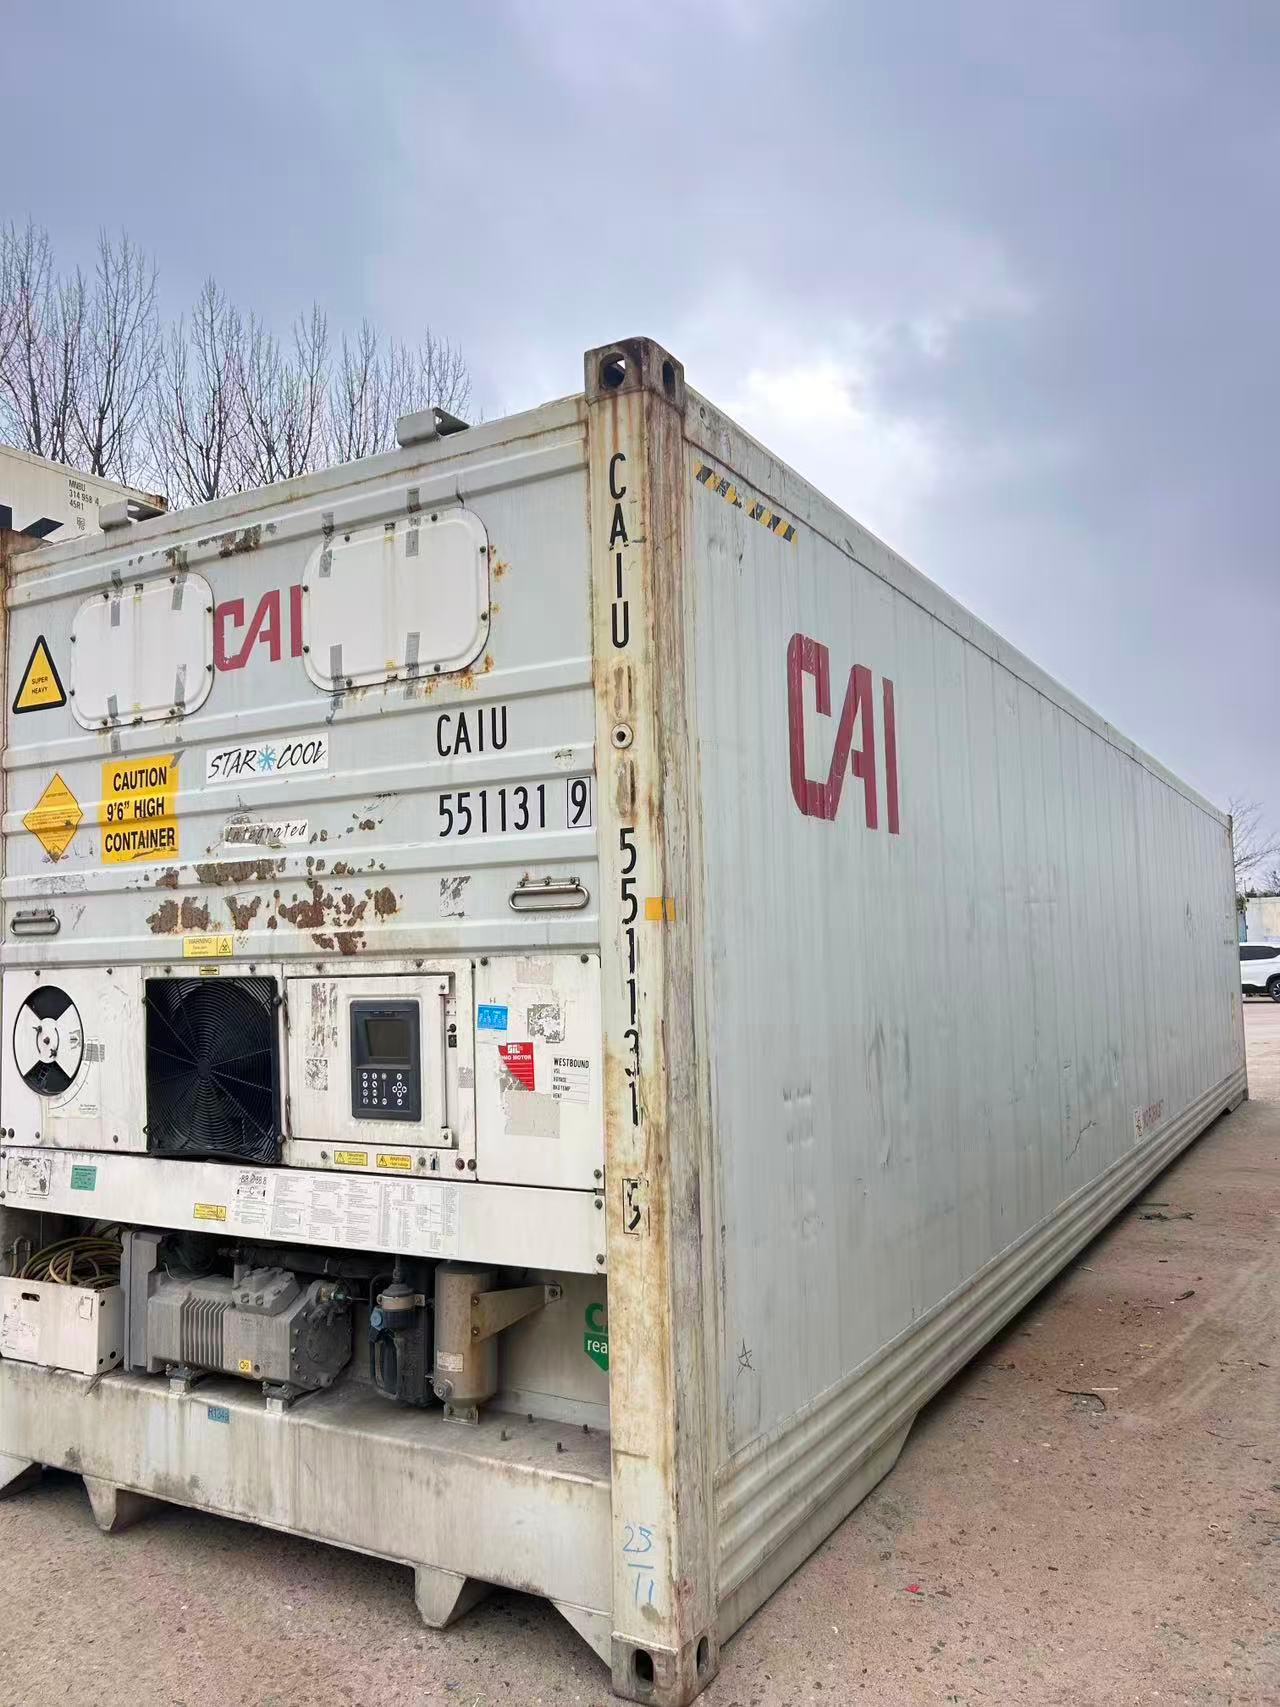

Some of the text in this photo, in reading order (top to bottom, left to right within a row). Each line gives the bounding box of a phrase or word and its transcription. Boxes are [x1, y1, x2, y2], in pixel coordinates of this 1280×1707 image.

[609, 452, 629, 648] CAIU
[214, 584, 302, 672] CAI
[32, 676, 48, 685] SUPER
[32, 686, 48, 695] HEAVY
[436, 705, 507, 757] CAIU
[787, 632, 900, 835] CAI
[208, 740, 326, 779] STAR COOL
[113, 766, 167, 792] CAUTION
[134, 796, 165, 818] HIGH
[438, 779, 588, 837] 551131 9
[105, 827, 175, 852] CONTAINER
[553, 1057, 590, 1069] WESTBOUND
[585, 1302, 608, 1333] C
